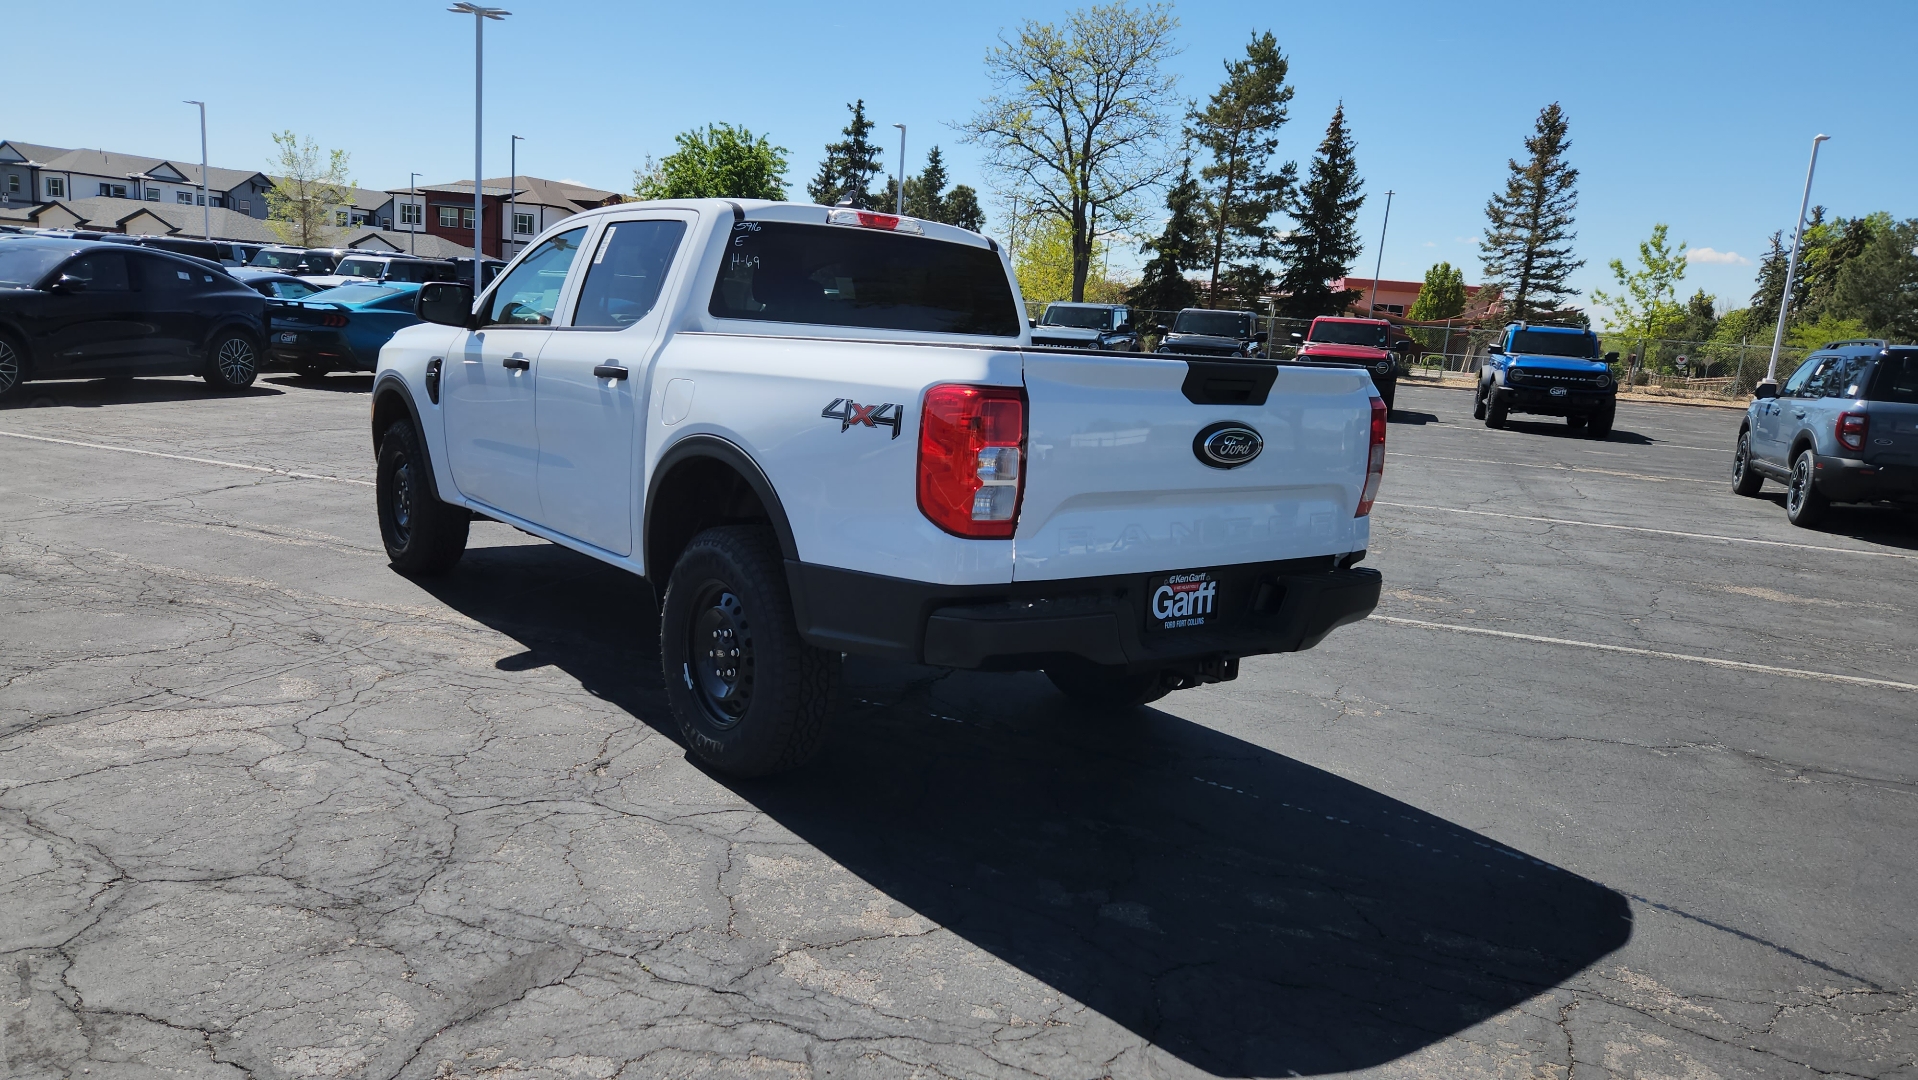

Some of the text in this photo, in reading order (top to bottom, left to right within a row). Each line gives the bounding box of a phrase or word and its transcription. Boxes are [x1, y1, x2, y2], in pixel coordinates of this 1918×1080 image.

[1220, 435, 1252, 455] Ford
[1175, 573, 1206, 584] Ken Garff
[1152, 581, 1216, 620] Garff
[1187, 617, 1205, 626] COLLINS
